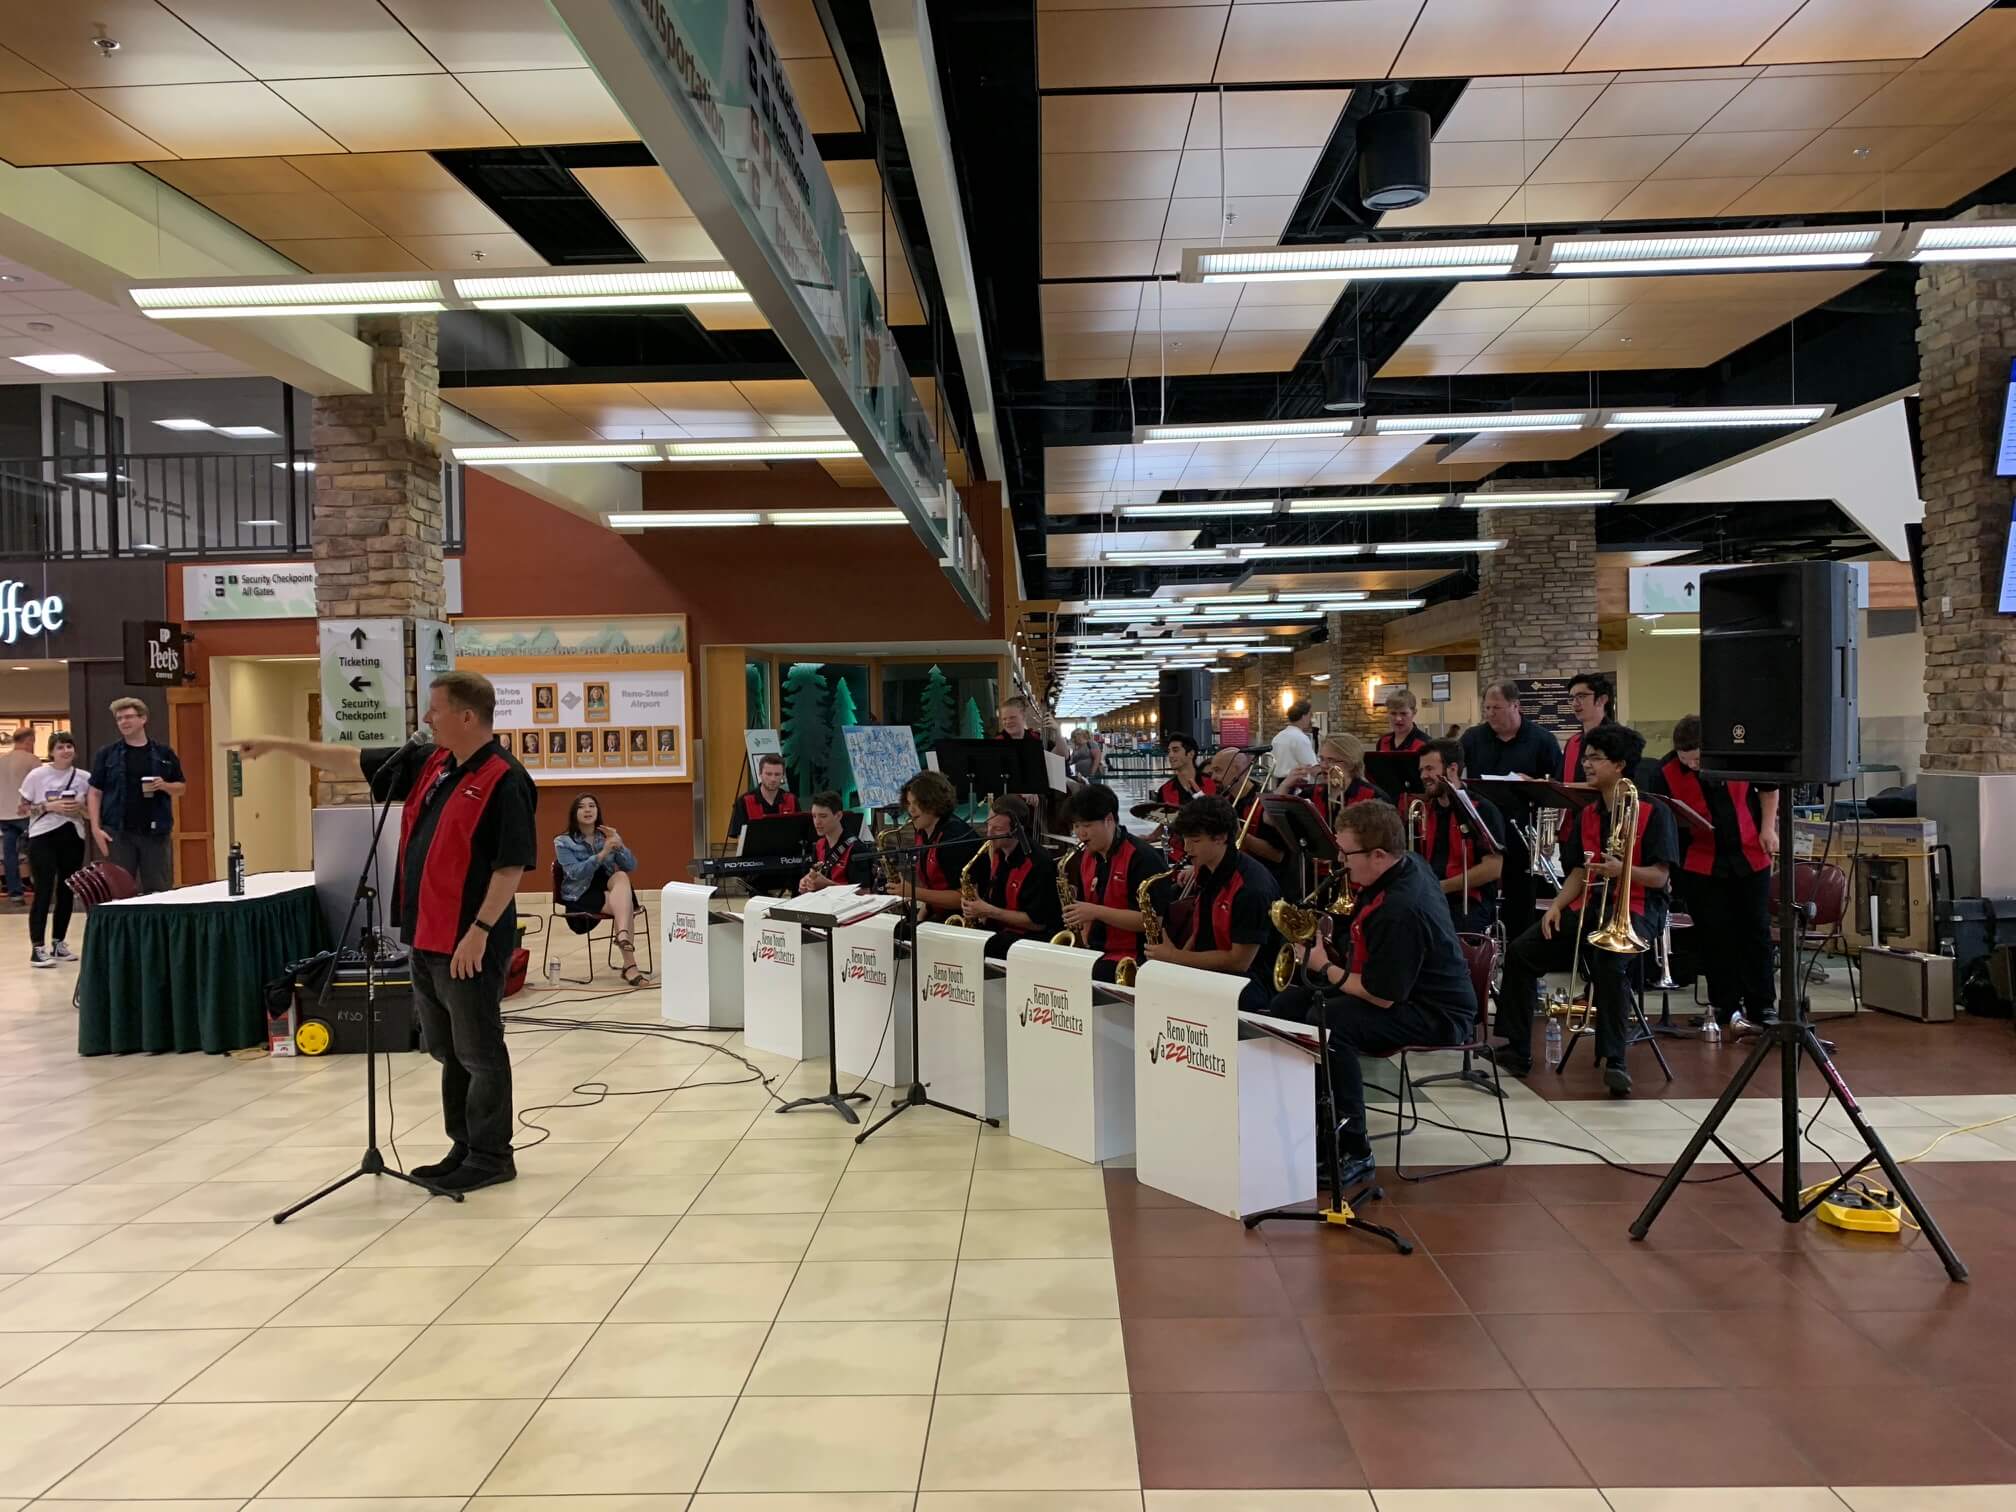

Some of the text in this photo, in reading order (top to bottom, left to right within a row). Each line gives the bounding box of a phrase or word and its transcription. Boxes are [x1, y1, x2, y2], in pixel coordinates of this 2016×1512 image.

[241, 573, 313, 585] Security Checkpoint
[242, 586, 275, 596] All Gates
[148, 640, 179, 671] Peet's
[339, 656, 380, 668] Ticketing
[341, 698, 380, 709] Security
[630, 700, 660, 709] Airport
[335, 711, 387, 721] Checkpoint
[339, 730, 385, 741] All Gates
[780, 856, 812, 864] Rolad
[762, 932, 785, 947] Reno Youth
[774, 947, 794, 963] Orchestra
[852, 949, 876, 966] Reno Youth
[864, 966, 887, 983] Orchestra
[934, 965, 963, 984] Reno Youth
[949, 984, 975, 1002] Orchestra
[1034, 987, 1068, 1010] Reno Youth
[1051, 1009, 1082, 1032] Orchestra
[1167, 1020, 1208, 1047] Reno Youth
[1187, 1045, 1226, 1073] Orchestra
